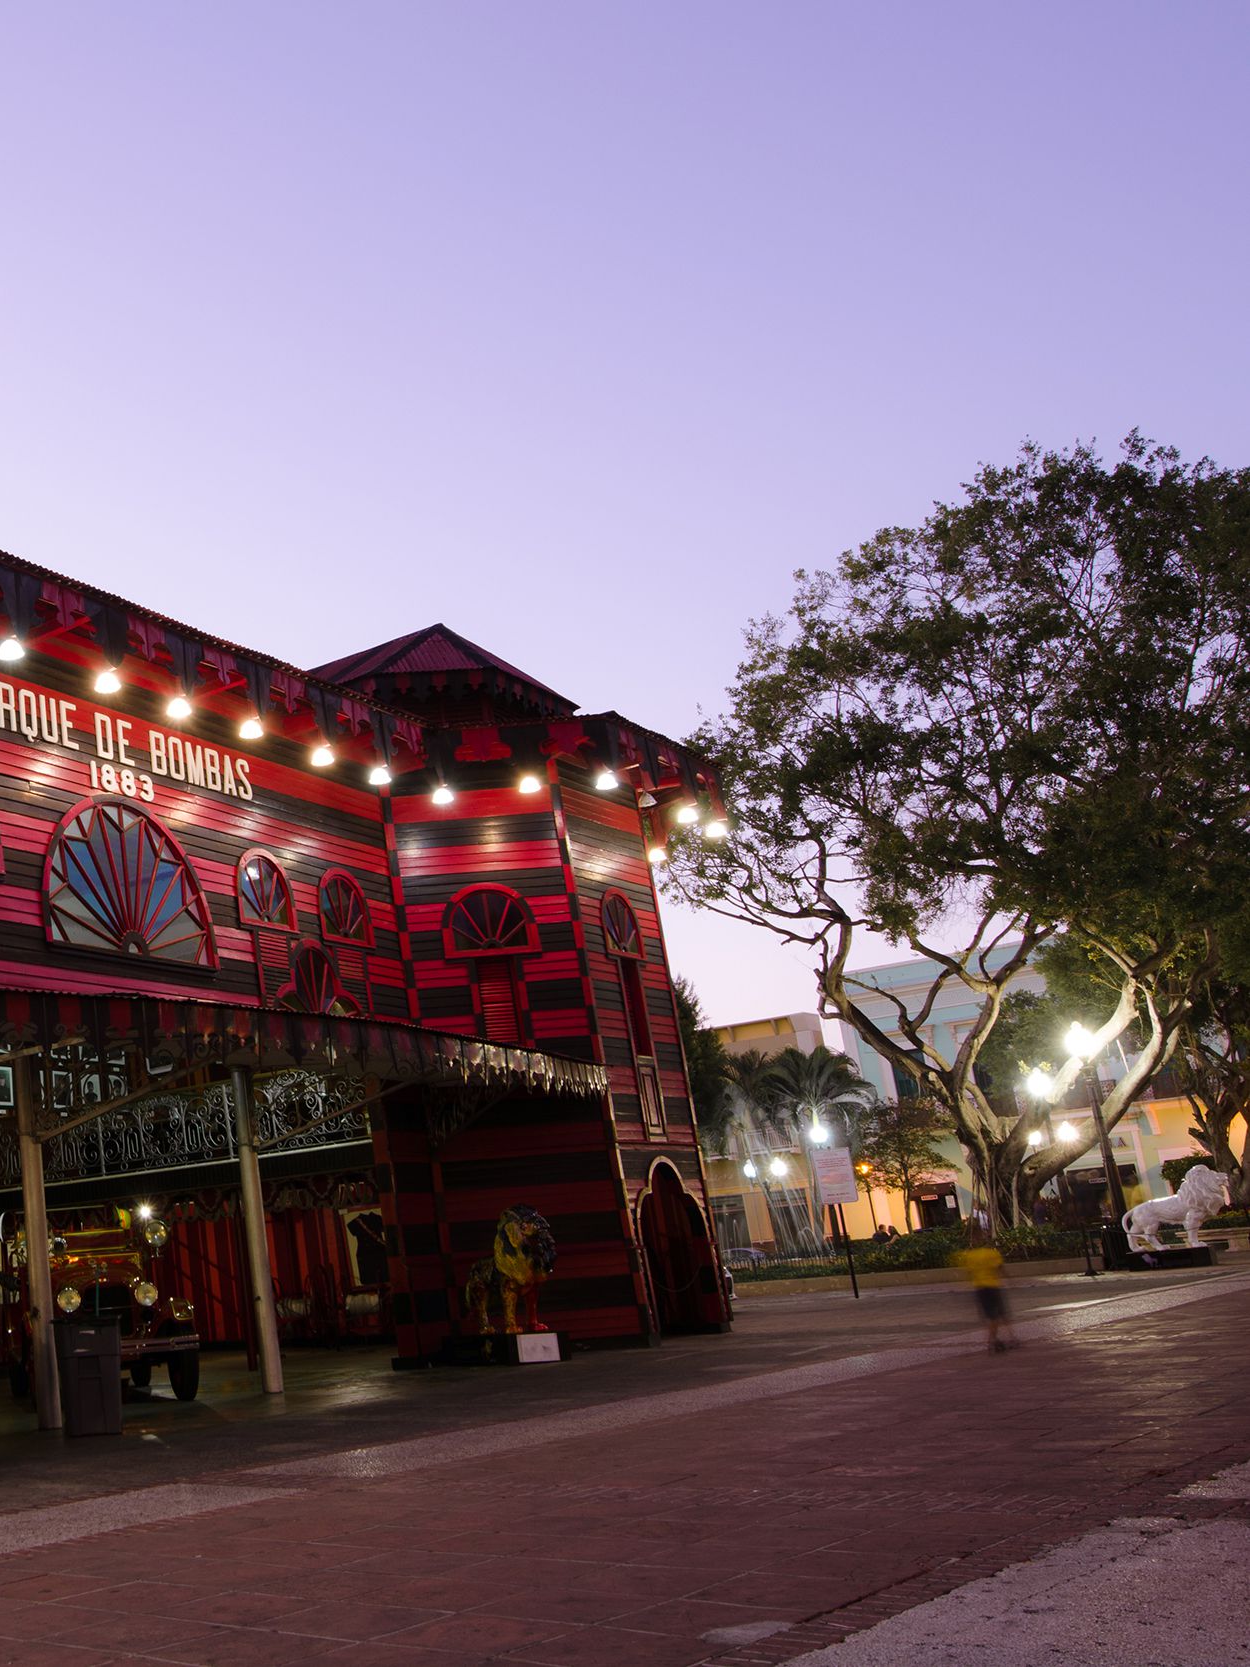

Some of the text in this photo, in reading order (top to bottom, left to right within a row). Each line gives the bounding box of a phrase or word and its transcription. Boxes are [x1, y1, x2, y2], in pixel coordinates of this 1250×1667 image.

[90, 760, 154, 801] 1883
[94, 712, 135, 766] DE
[149, 730, 253, 800] BOMBAS
